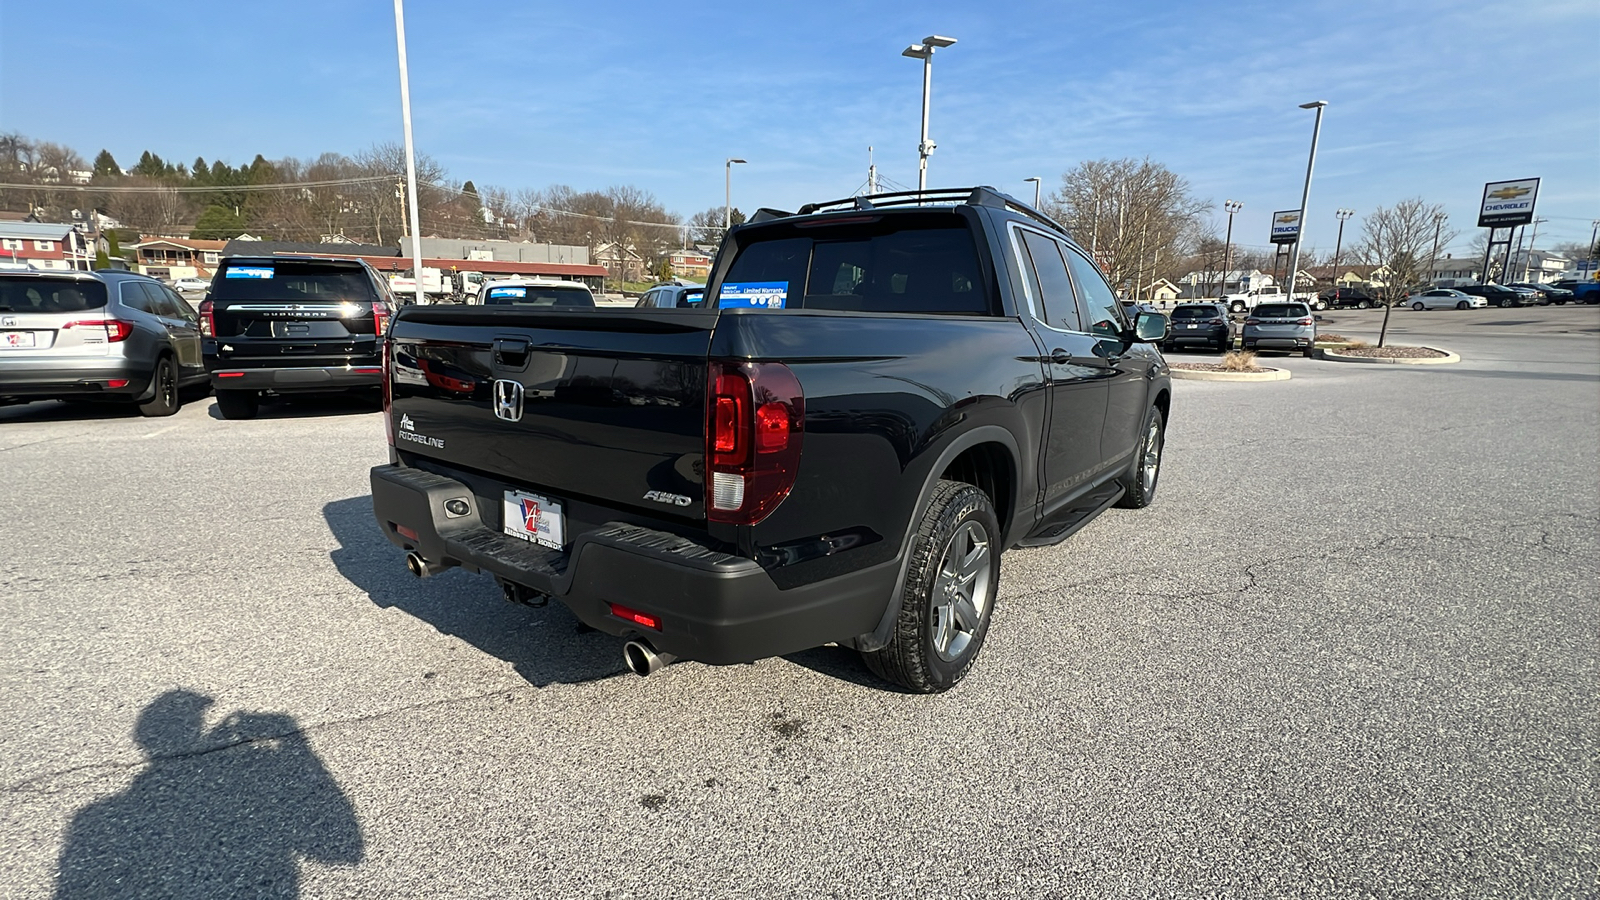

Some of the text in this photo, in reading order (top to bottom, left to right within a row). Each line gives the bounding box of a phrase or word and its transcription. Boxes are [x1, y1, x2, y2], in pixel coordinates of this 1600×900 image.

[1485, 202, 1529, 211] CHEVROLET
[399, 430, 445, 449] RIDGELINE
[642, 490, 692, 507] AWD
